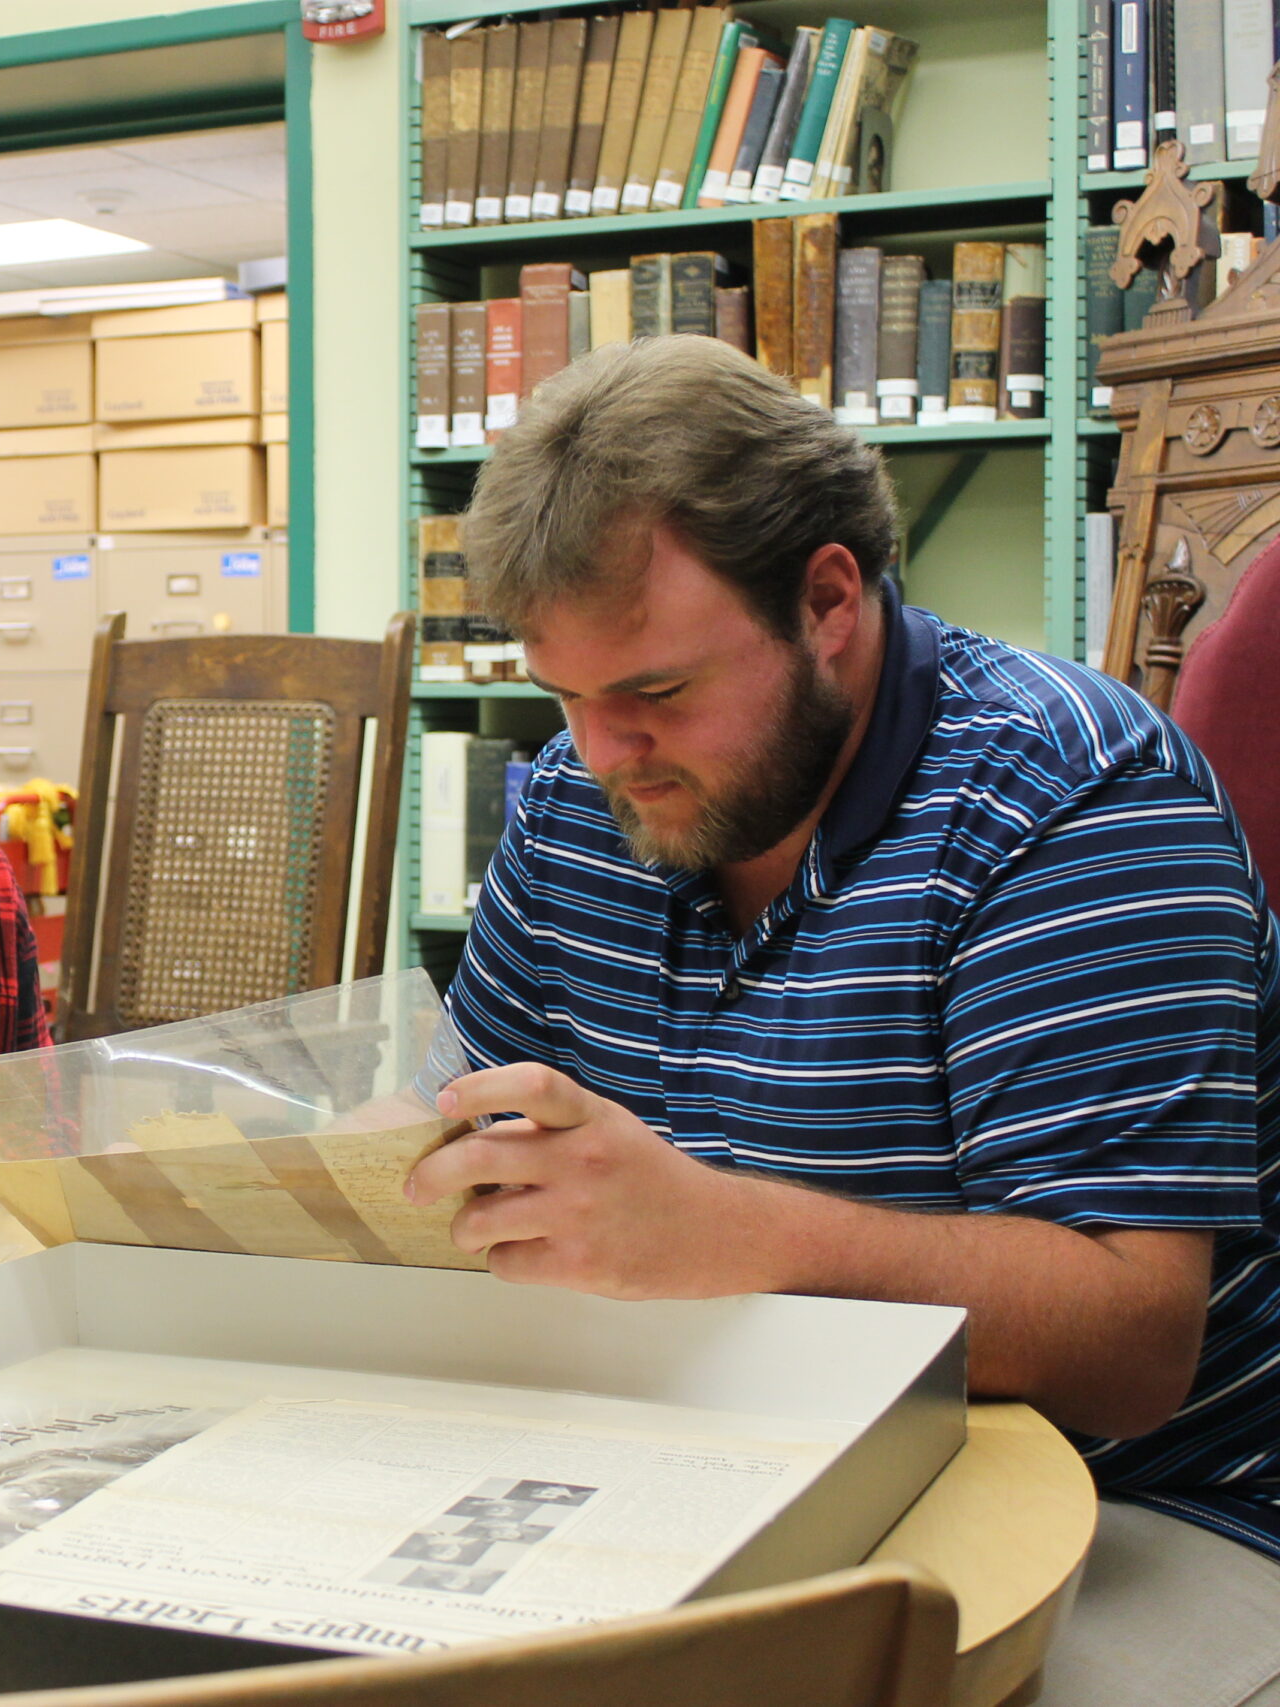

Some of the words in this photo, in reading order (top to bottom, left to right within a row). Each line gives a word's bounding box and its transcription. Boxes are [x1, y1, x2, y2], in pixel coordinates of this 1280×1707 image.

[318, 21, 357, 38] FIRE
[36, 1547, 147, 1570] Degrees
[157, 1564, 272, 1586] Receive
[283, 1580, 437, 1606] Graduates
[72, 1594, 254, 1636] Lights
[445, 1600, 564, 1622] College
[270, 1615, 451, 1654] ampus
